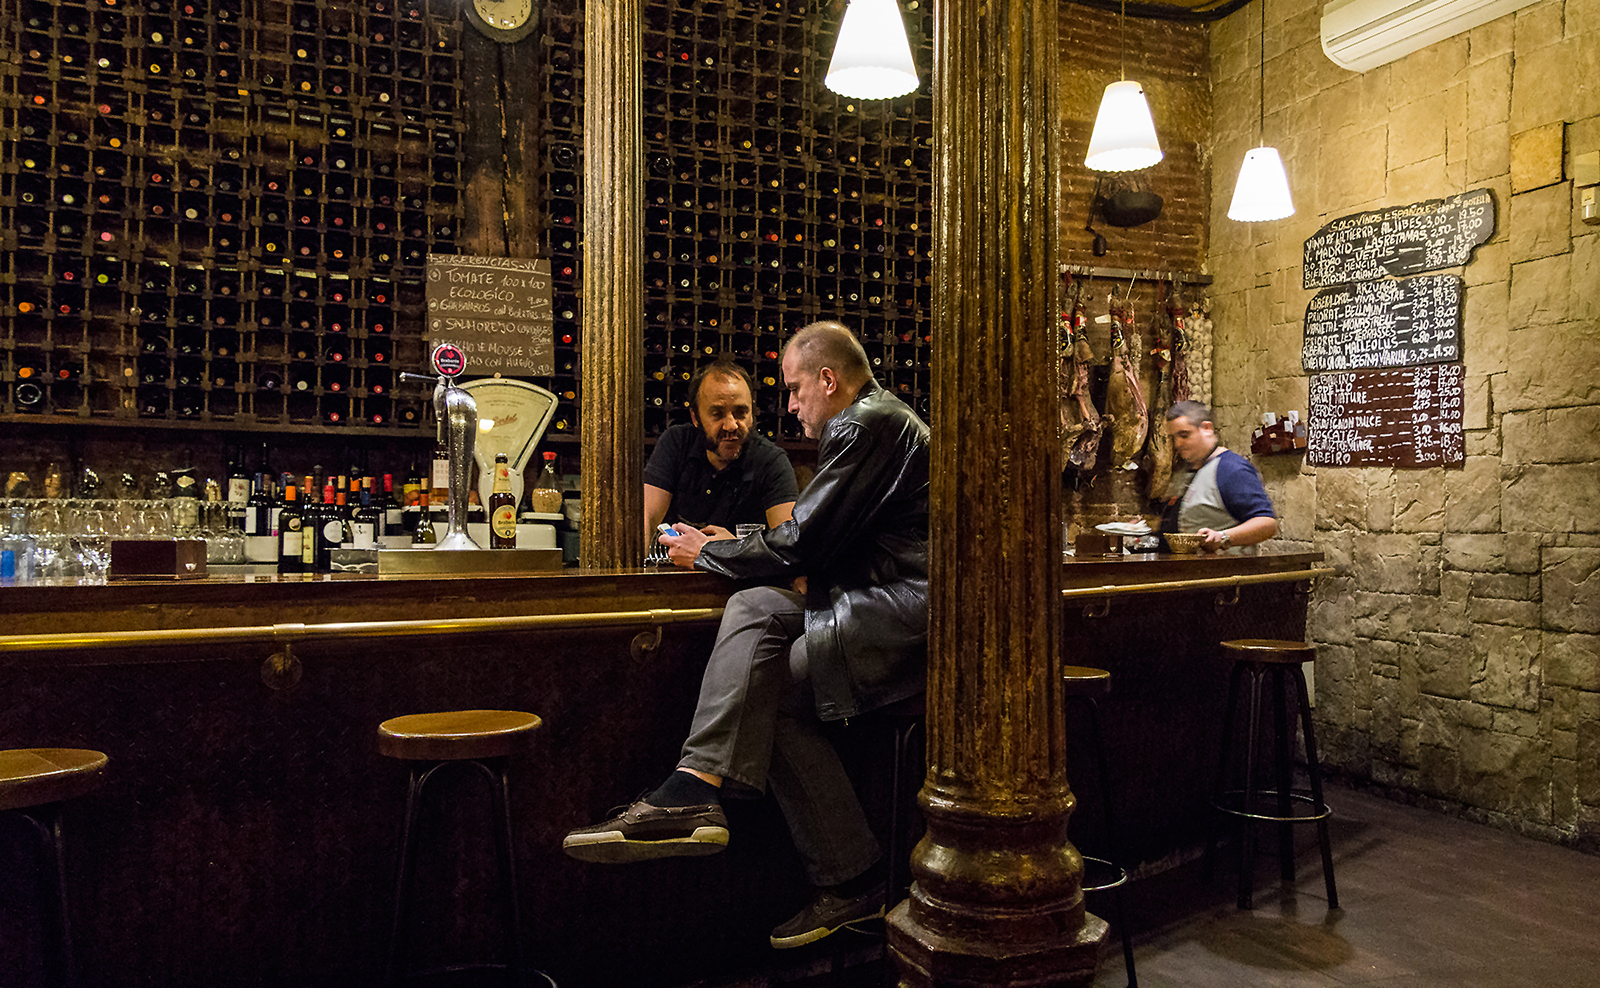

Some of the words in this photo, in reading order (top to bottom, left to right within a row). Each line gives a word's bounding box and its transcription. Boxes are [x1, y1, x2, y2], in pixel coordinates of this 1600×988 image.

[1315, 243, 1352, 260] MADRID
[445, 267, 495, 285] TOMATE
[446, 318, 516, 335] SALMOREJO
